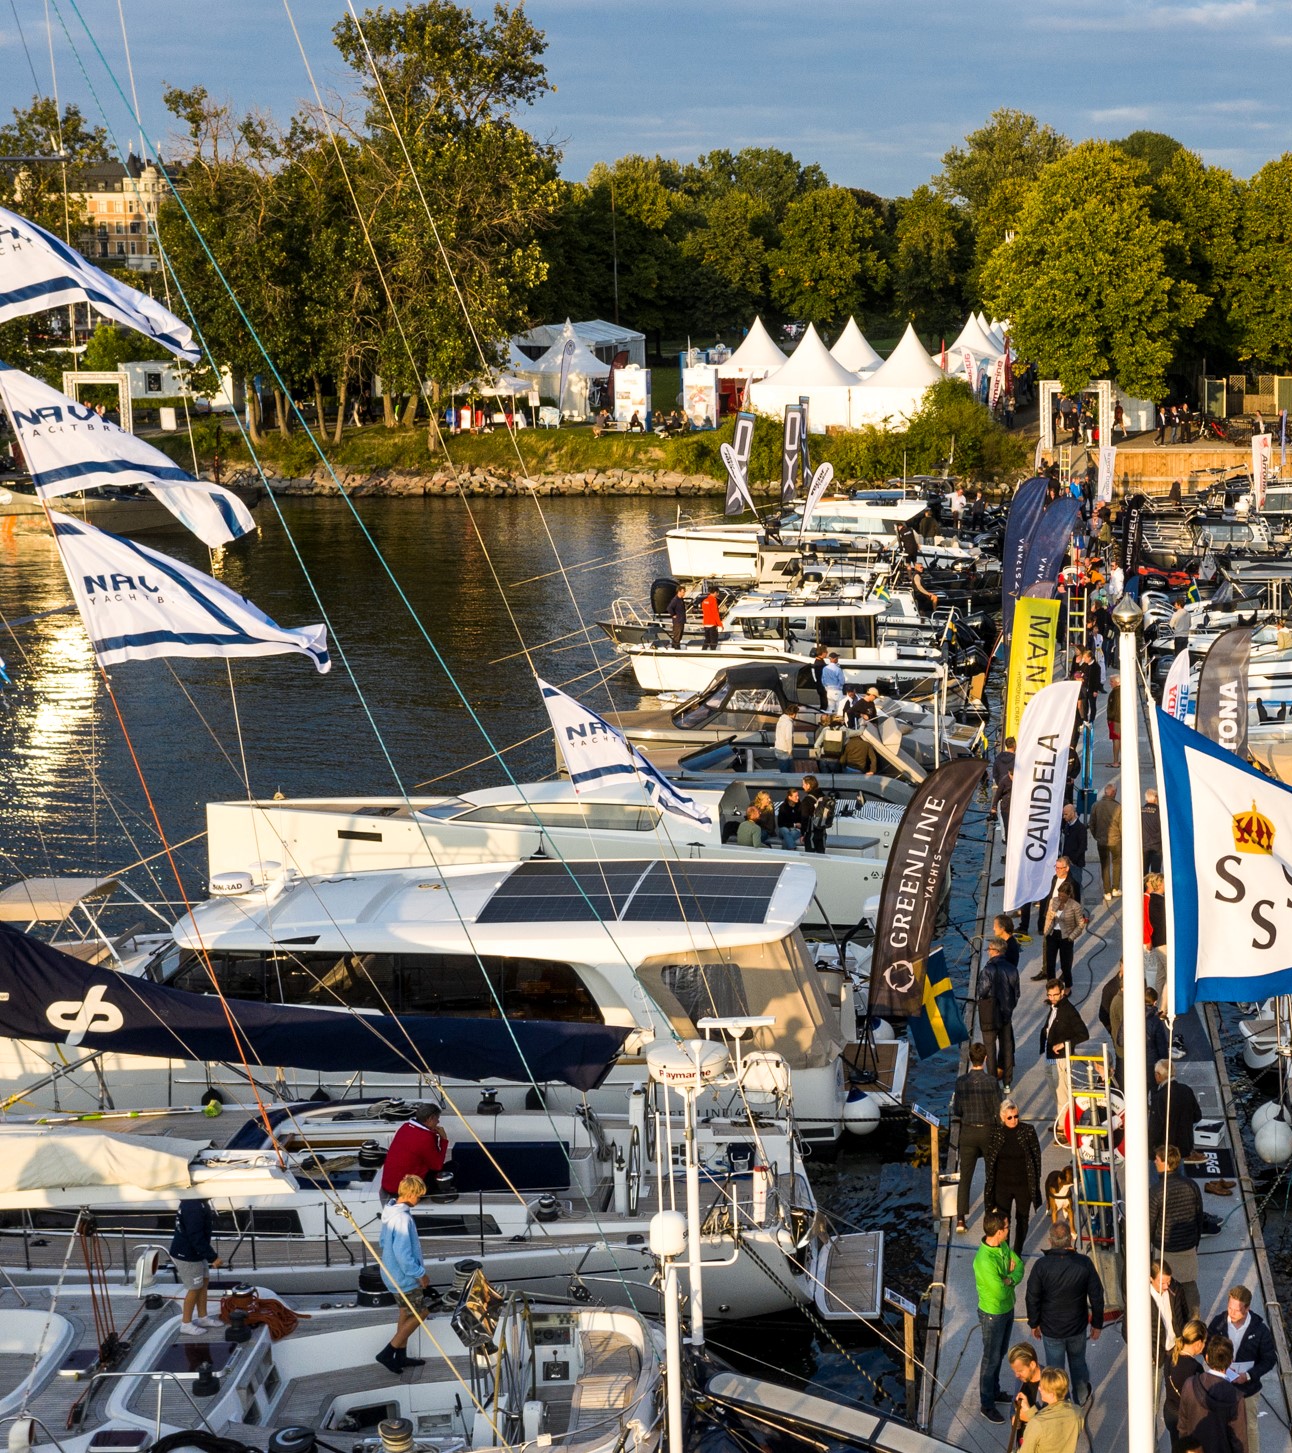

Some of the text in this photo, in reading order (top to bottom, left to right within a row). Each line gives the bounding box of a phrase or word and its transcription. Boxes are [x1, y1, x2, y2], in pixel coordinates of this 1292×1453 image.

[1126, 508, 1138, 566] HIGHFIELD
[1023, 615, 1052, 706] MAN
[1218, 680, 1238, 750] TONA
[1025, 733, 1060, 862] CANDELA
[889, 795, 945, 948] GREENLINE
[924, 855, 942, 899] YACHTS
[659, 1068, 712, 1081] Raymarne
